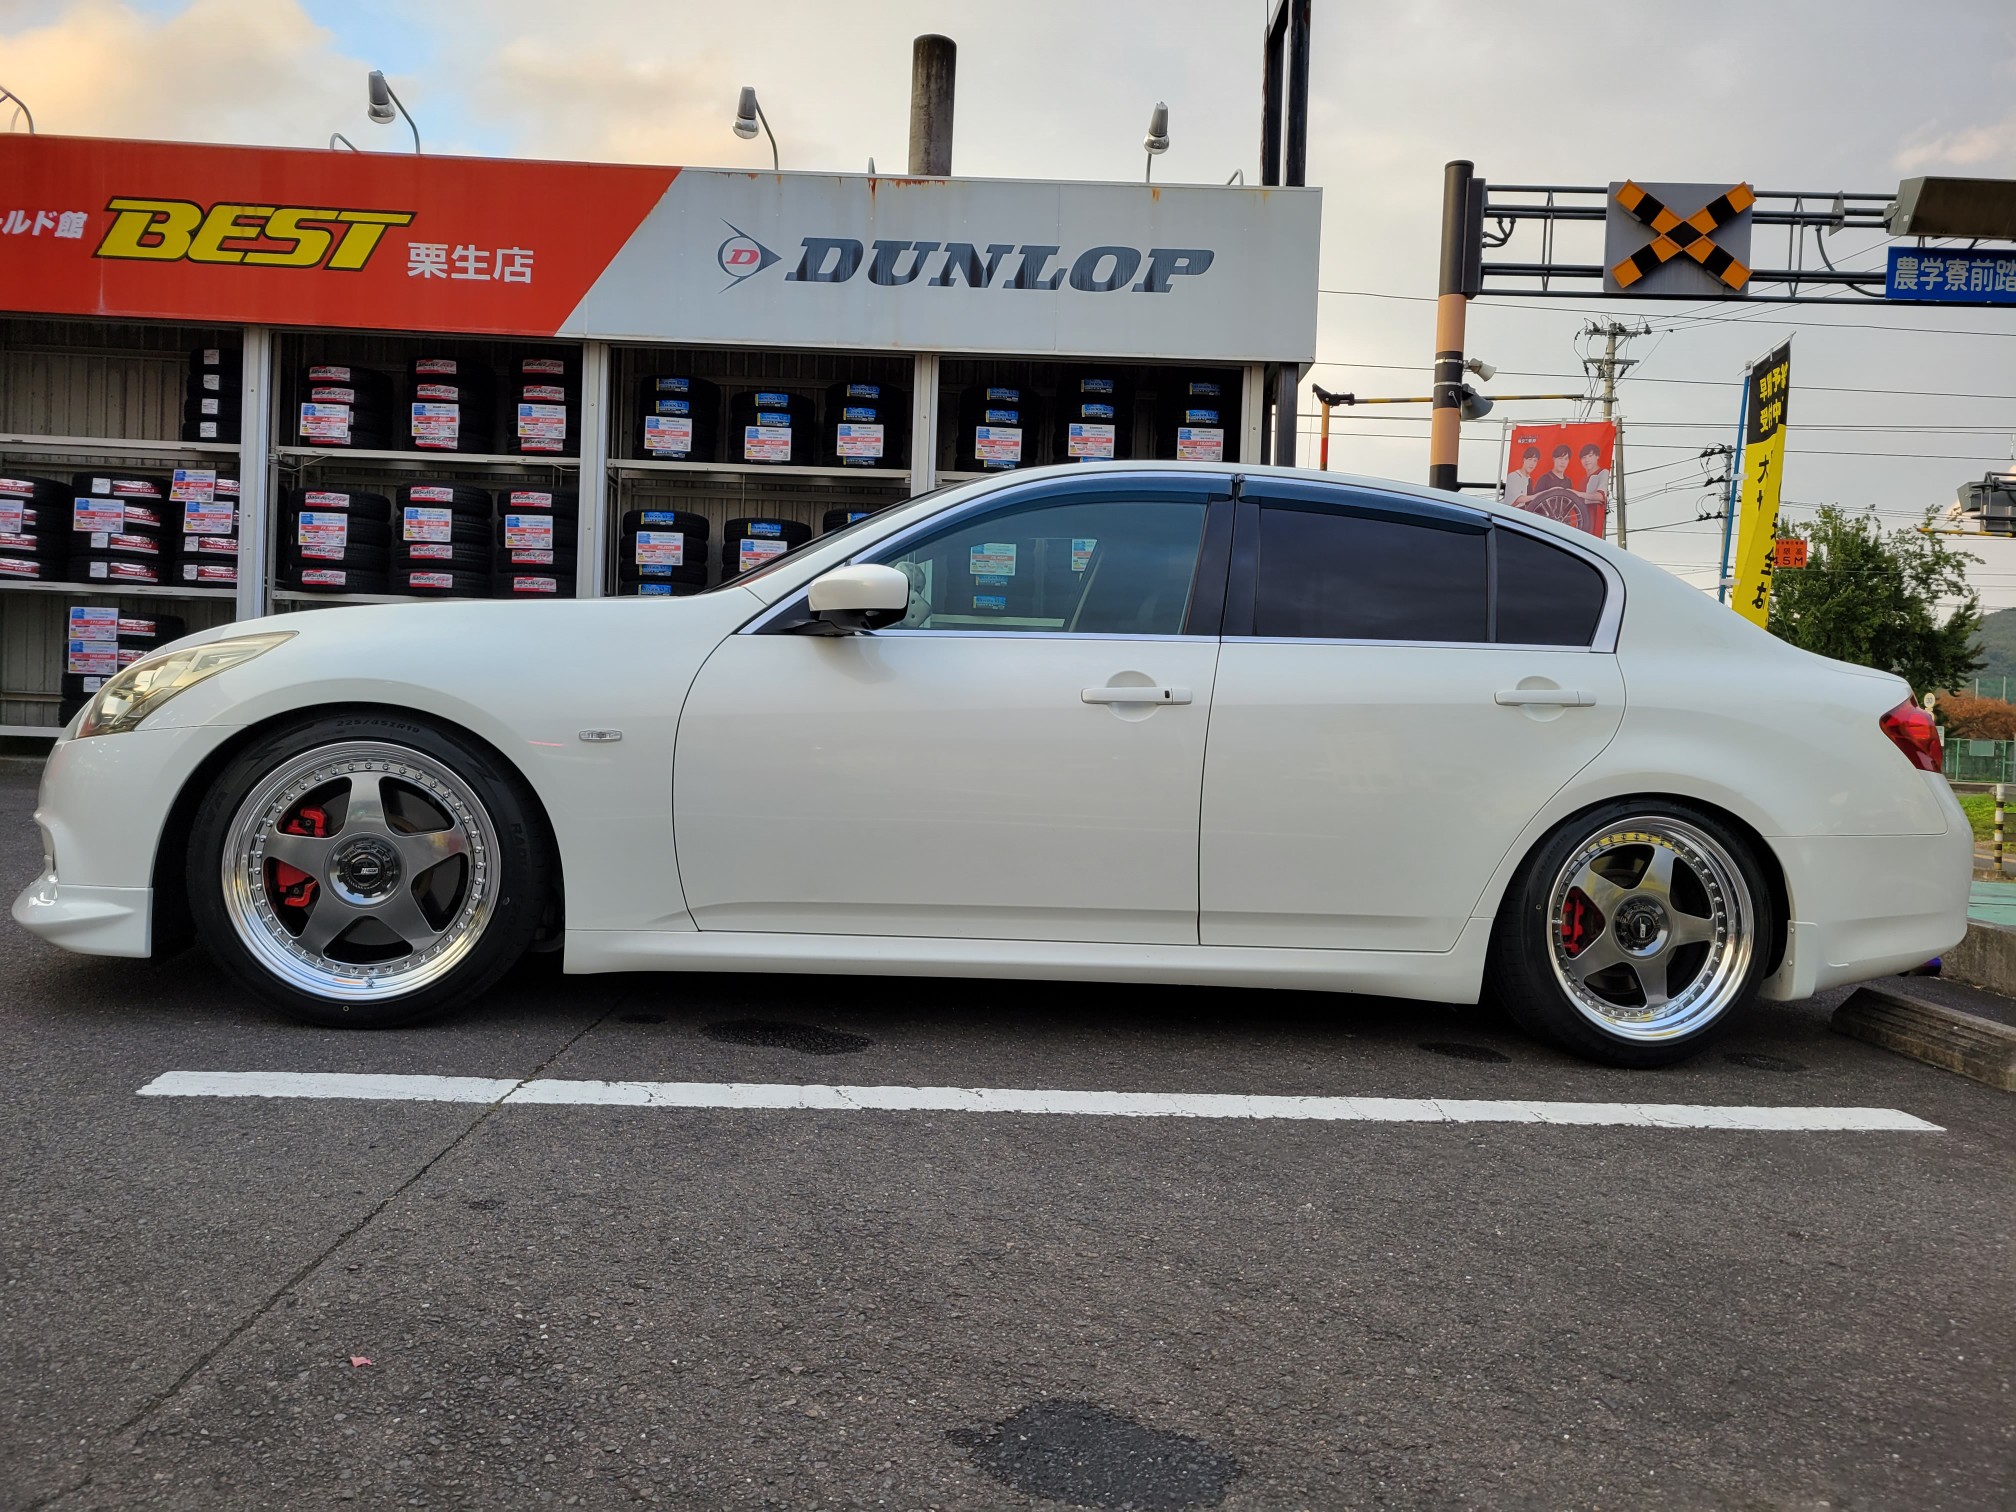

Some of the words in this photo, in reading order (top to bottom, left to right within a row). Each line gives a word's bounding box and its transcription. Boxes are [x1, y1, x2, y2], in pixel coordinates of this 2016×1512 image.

[0, 209, 89, 239] ルド館
[94, 196, 417, 272] BEST
[407, 241, 534, 284] 栗生店
[784, 236, 1216, 293] DUNLOP
